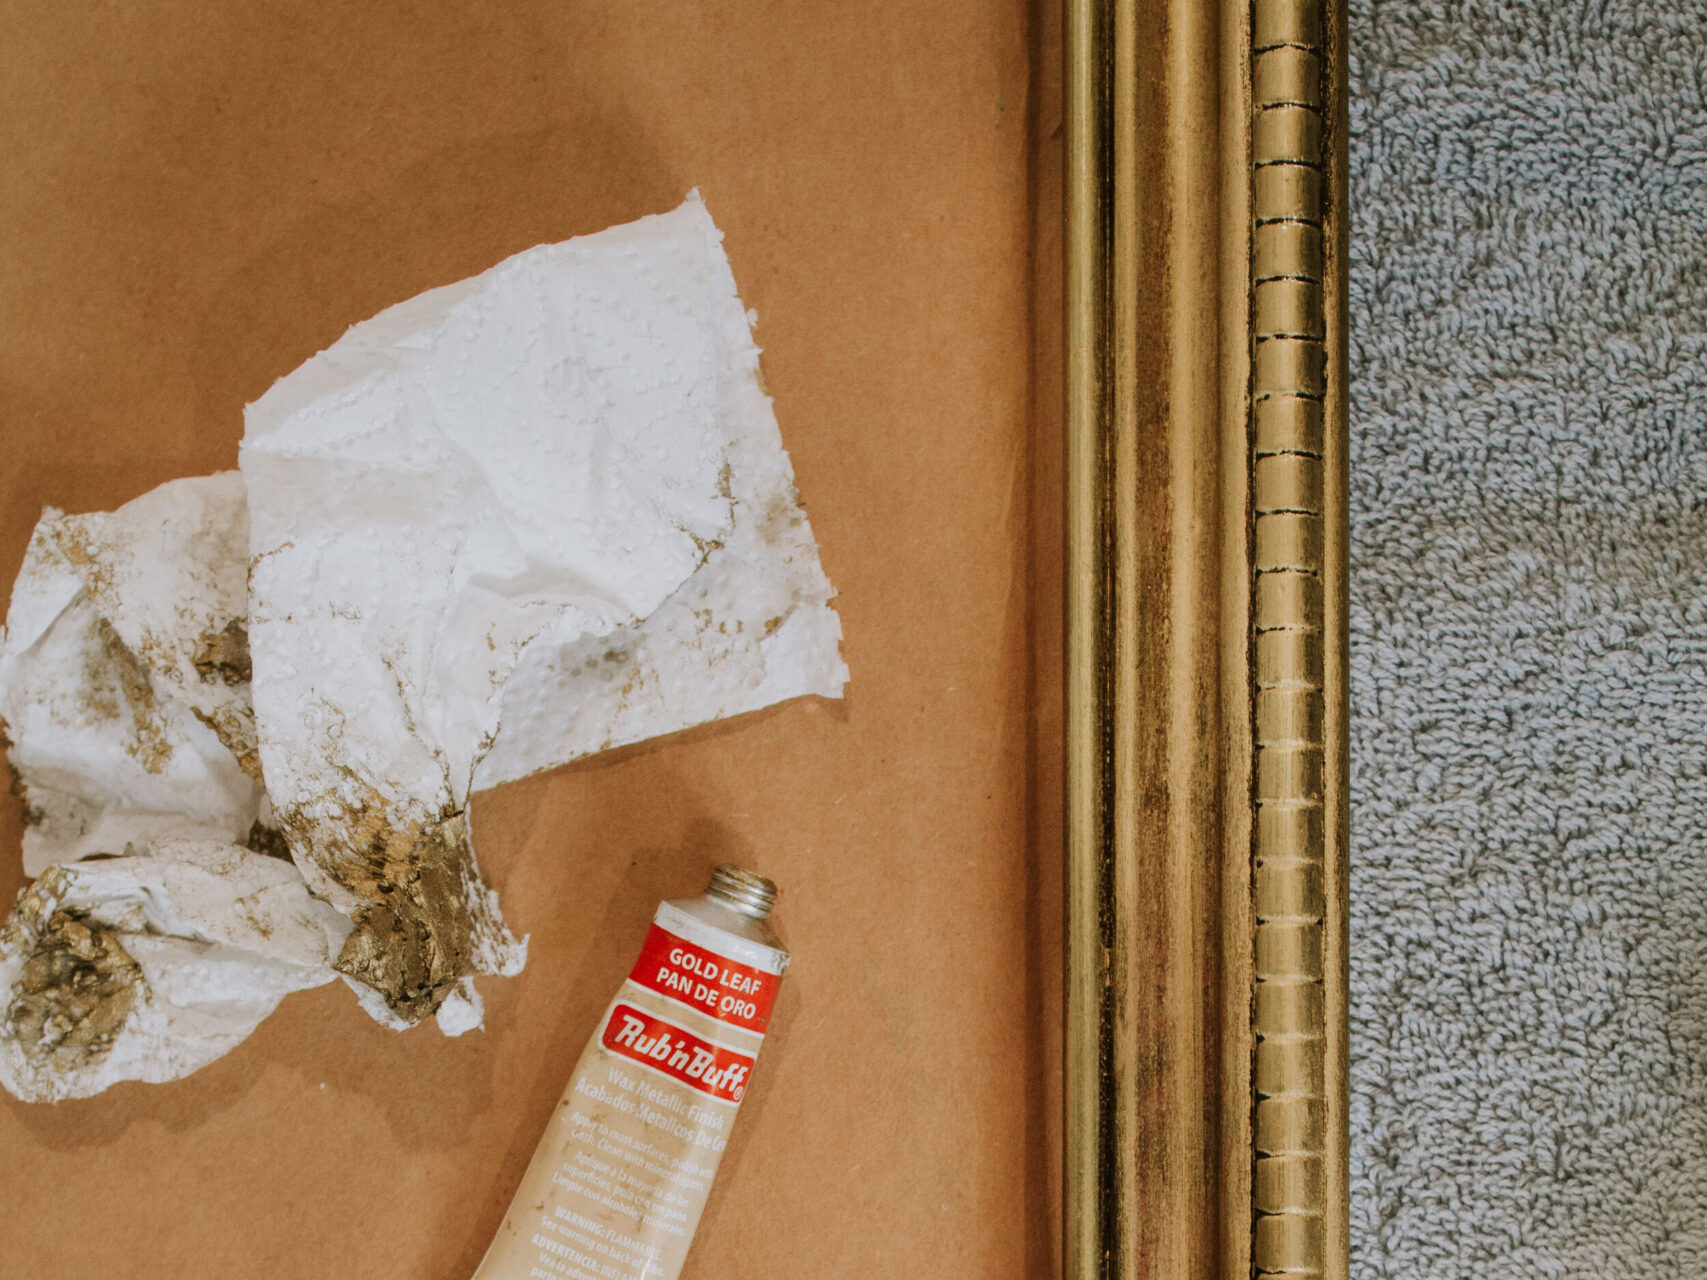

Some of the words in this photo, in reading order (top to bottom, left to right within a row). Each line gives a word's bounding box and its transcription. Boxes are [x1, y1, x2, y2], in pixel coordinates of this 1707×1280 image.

[656, 966, 693, 995] PAN
[693, 983, 720, 1007] DE
[719, 995, 756, 1019] ORO
[669, 948, 719, 980] GOLD
[719, 968, 762, 995] LEAF
[575, 1076, 635, 1114] Acabados
[694, 1129, 712, 1149] De
[607, 1066, 636, 1092] Wax
[635, 1079, 686, 1115] Metallic
[687, 1104, 724, 1131] Finish
[597, 1123, 609, 1136] to
[608, 1129, 633, 1147] most
[671, 1159, 699, 1176] polish
[622, 1151, 645, 1167] with
[582, 1187, 601, 1202] con
[663, 1190, 677, 1203] de
[540, 1214, 558, 1232] See
[558, 1224, 596, 1250] warning
[595, 1242, 609, 1254] on
[608, 1246, 631, 1264] back
[630, 1257, 644, 1269] of
[554, 1205, 605, 1237] WARNING:
[531, 1233, 600, 1272] ADVERTENCIA:
[538, 1250, 556, 1269] Vea
